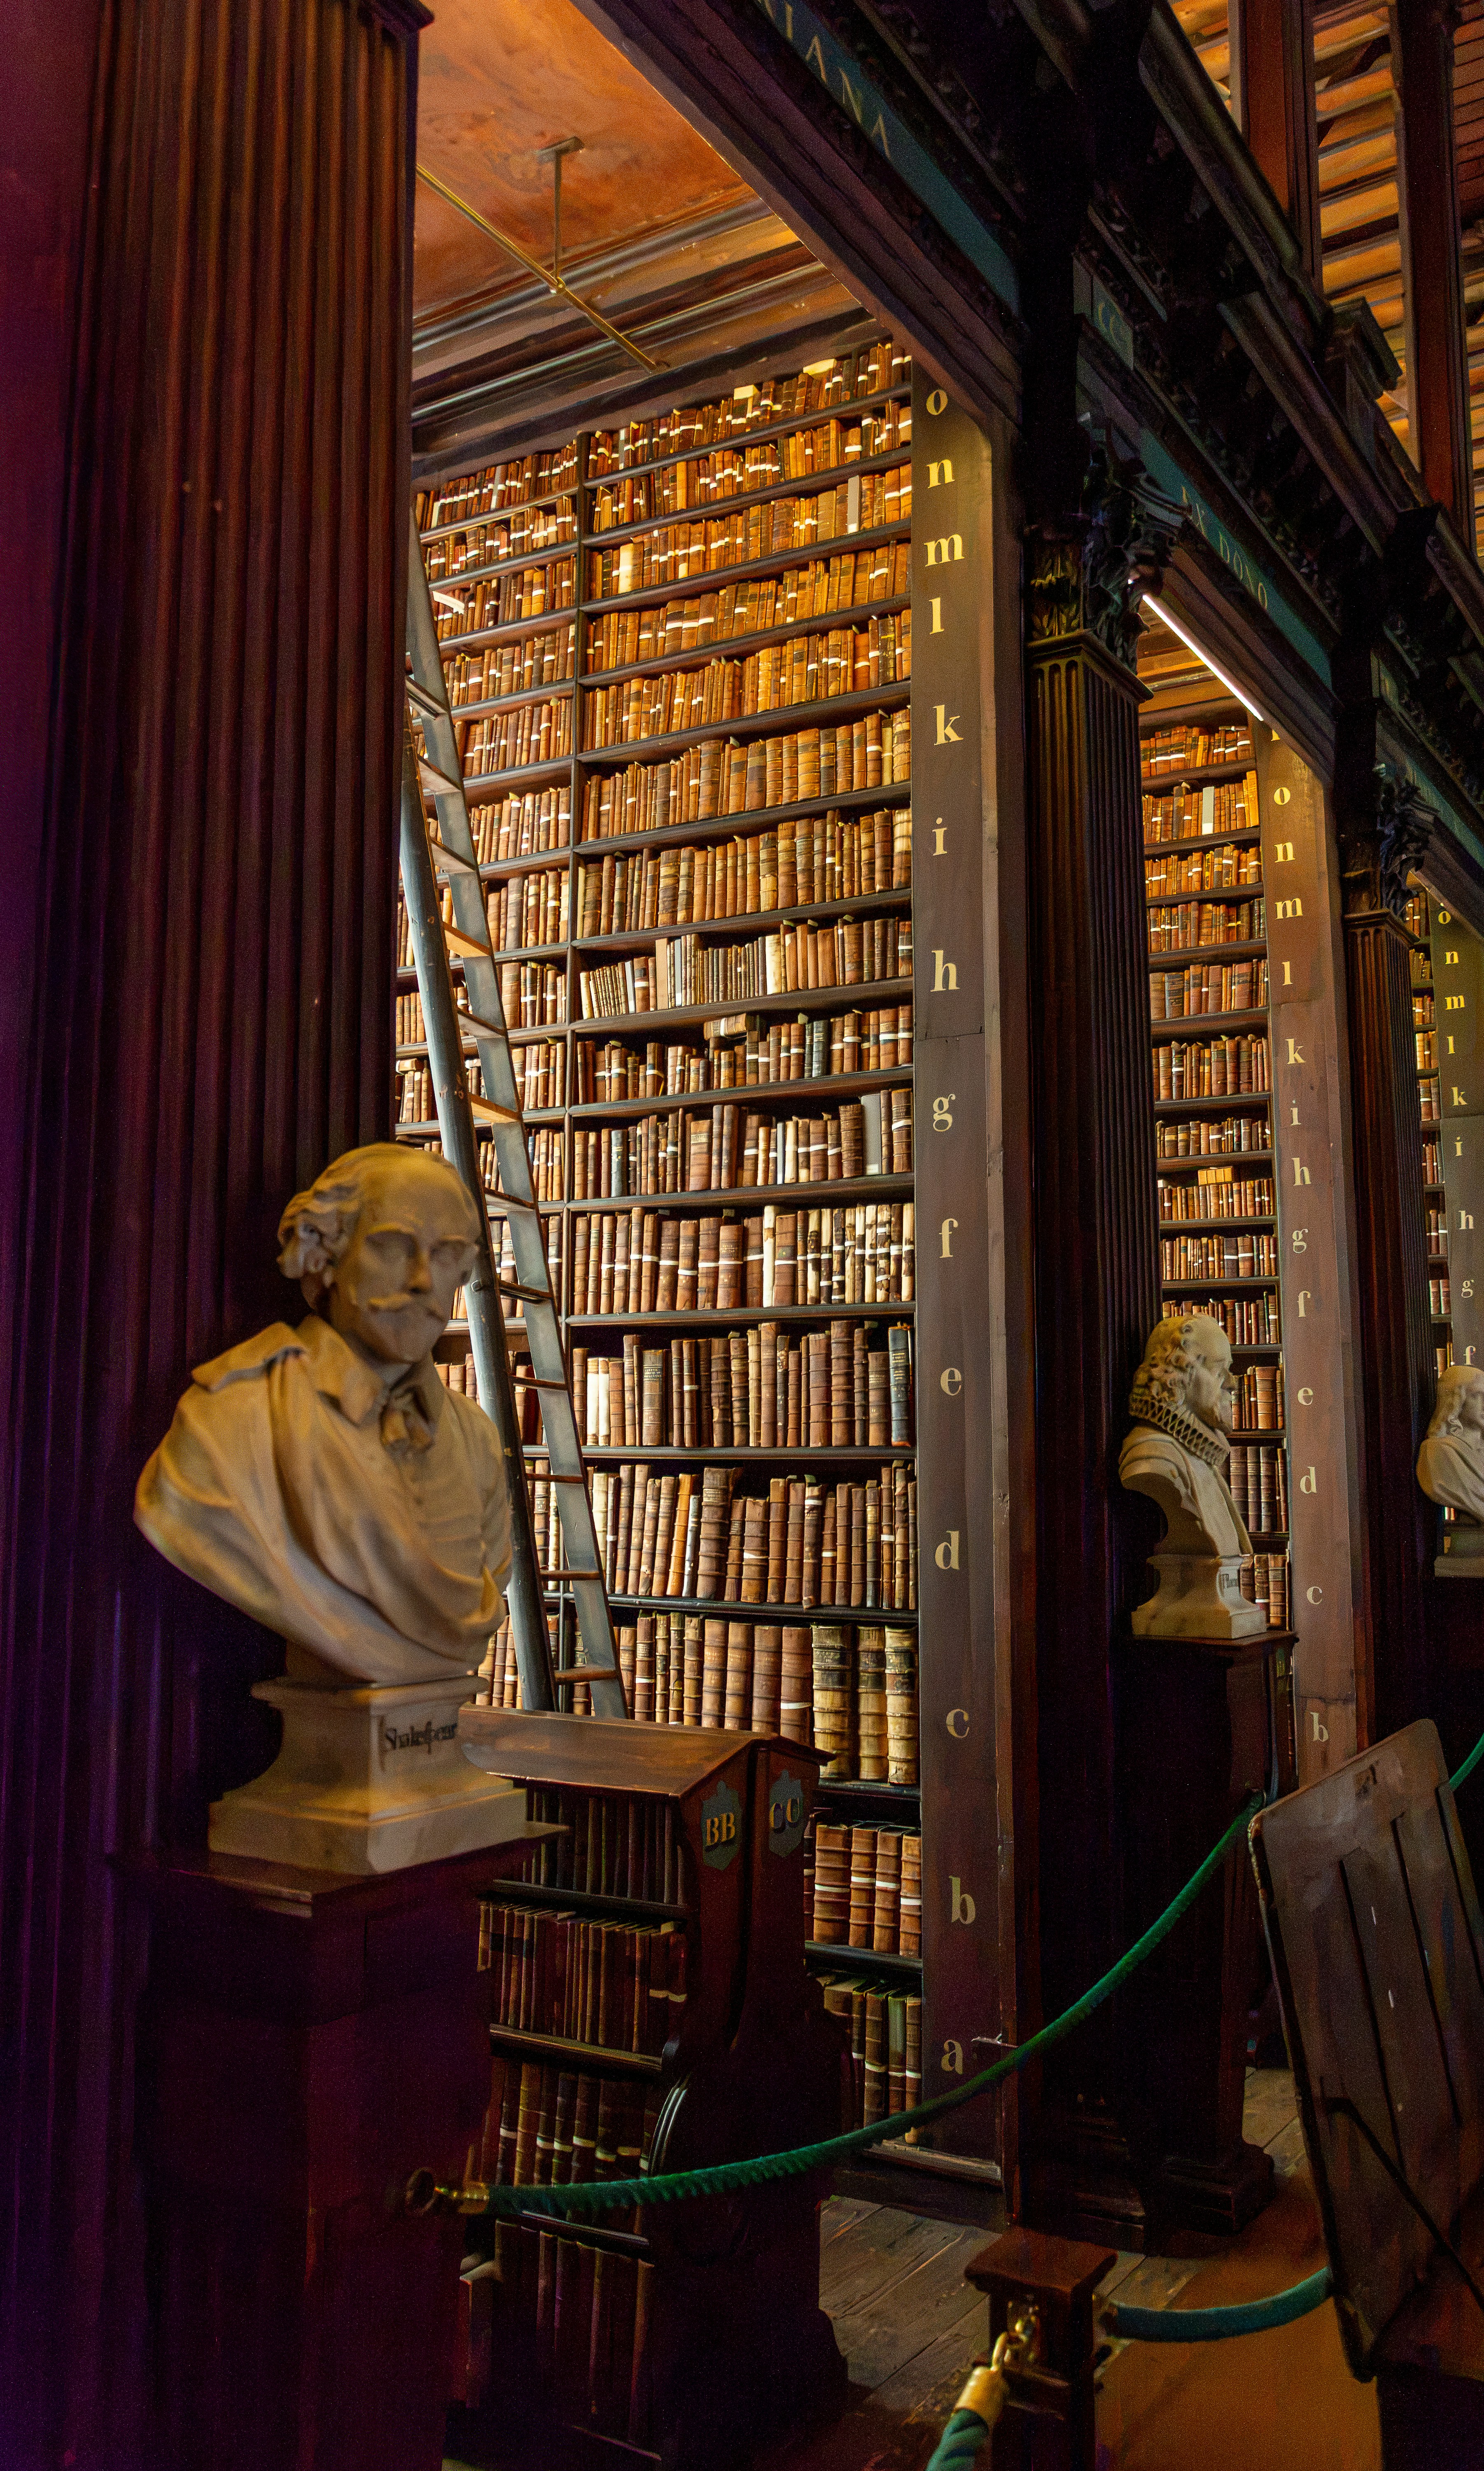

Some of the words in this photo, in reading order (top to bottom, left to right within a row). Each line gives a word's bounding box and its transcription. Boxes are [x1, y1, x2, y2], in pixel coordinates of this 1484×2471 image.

[926, 390, 947, 415] o
[928, 460, 954, 488] n
[925, 534, 964, 566] m
[934, 705, 963, 745] k
[1274, 787, 1290, 805] o
[933, 817, 947, 855] i
[1275, 842, 1294, 862] n
[1276, 898, 1302, 919] m
[1438, 911, 1451, 924] o
[1446, 951, 1458, 964] n
[931, 950, 959, 991] h
[1445, 995, 1465, 1009] m
[1286, 1039, 1304, 1064] k
[1452, 1087, 1466, 1105] k
[933, 1094, 956, 1131] g
[1291, 1100, 1300, 1125] i
[1455, 1137, 1462, 1156] i
[1292, 1158, 1311, 1186] h
[1460, 1210, 1473, 1229] h
[940, 1218, 958, 1258] f
[1292, 1228, 1308, 1253] g
[1461, 1280, 1474, 1298] g
[1298, 1291, 1311, 1317] f
[1465, 1346, 1475, 1365] f
[940, 1368, 961, 1396] e
[1297, 1387, 1313, 1405] e
[1300, 1467, 1316, 1493] d
[935, 1531, 959, 1569] d
[1306, 1586, 1322, 1605] c
[946, 1709, 969, 1738] c
[1311, 1712, 1328, 1742] b
[706, 1812, 735, 1845] BB
[949, 1876, 975, 1924] b
[941, 2039, 963, 2074] a
